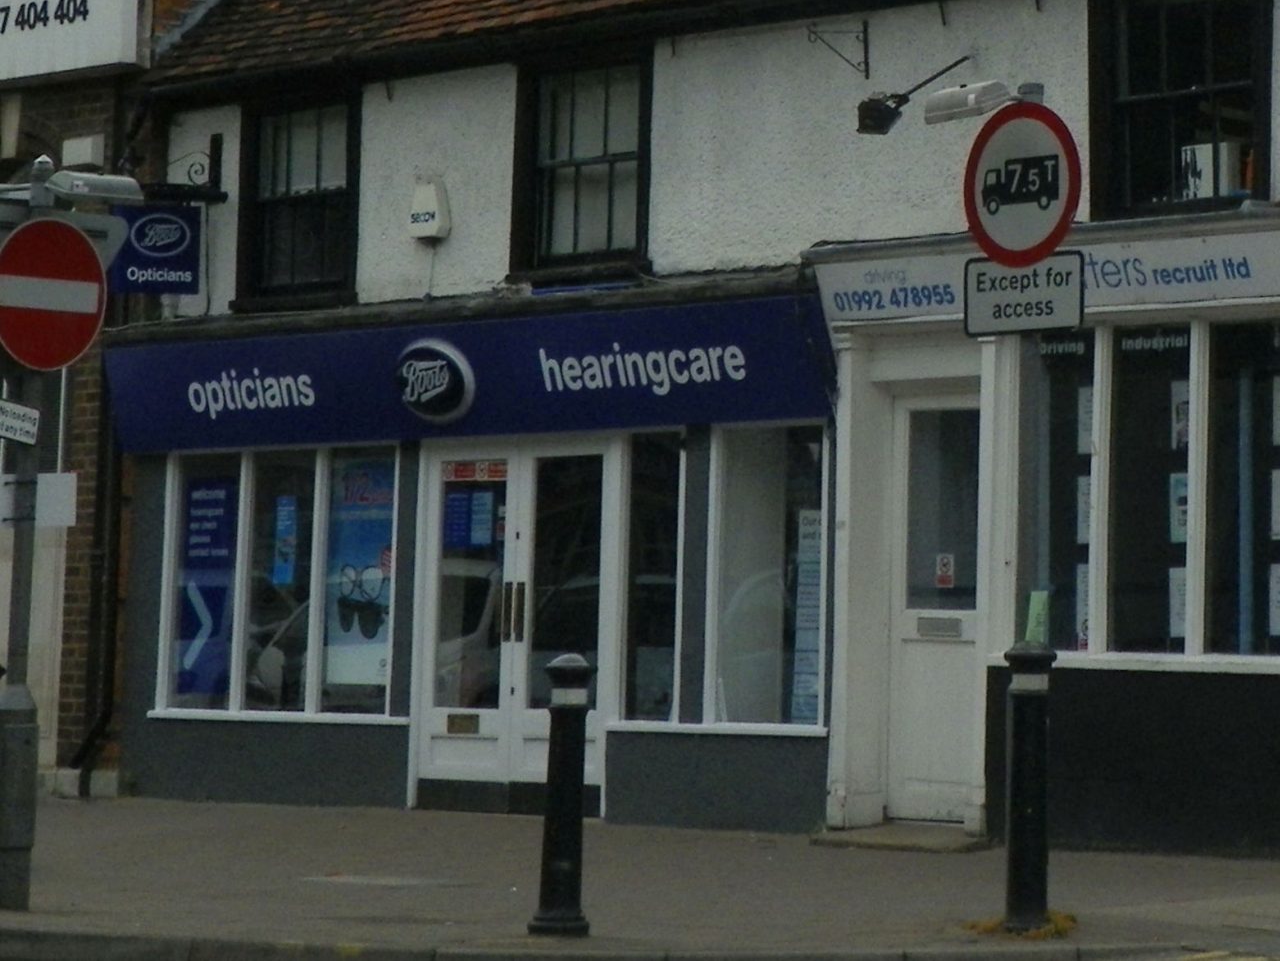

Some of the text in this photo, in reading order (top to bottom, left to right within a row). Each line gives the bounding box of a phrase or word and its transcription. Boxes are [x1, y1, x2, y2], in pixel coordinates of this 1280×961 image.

[15, 0, 50, 31] 404
[126, 267, 193, 284] Opticians
[976, 267, 1073, 294] Except for
[1083, 252, 1252, 289] ters recruit ltd
[833, 283, 956, 312] 01992 478955
[993, 299, 1054, 319] access
[402, 359, 450, 403] Boots
[539, 342, 746, 395] hearingcare
[188, 367, 315, 420] opticians
